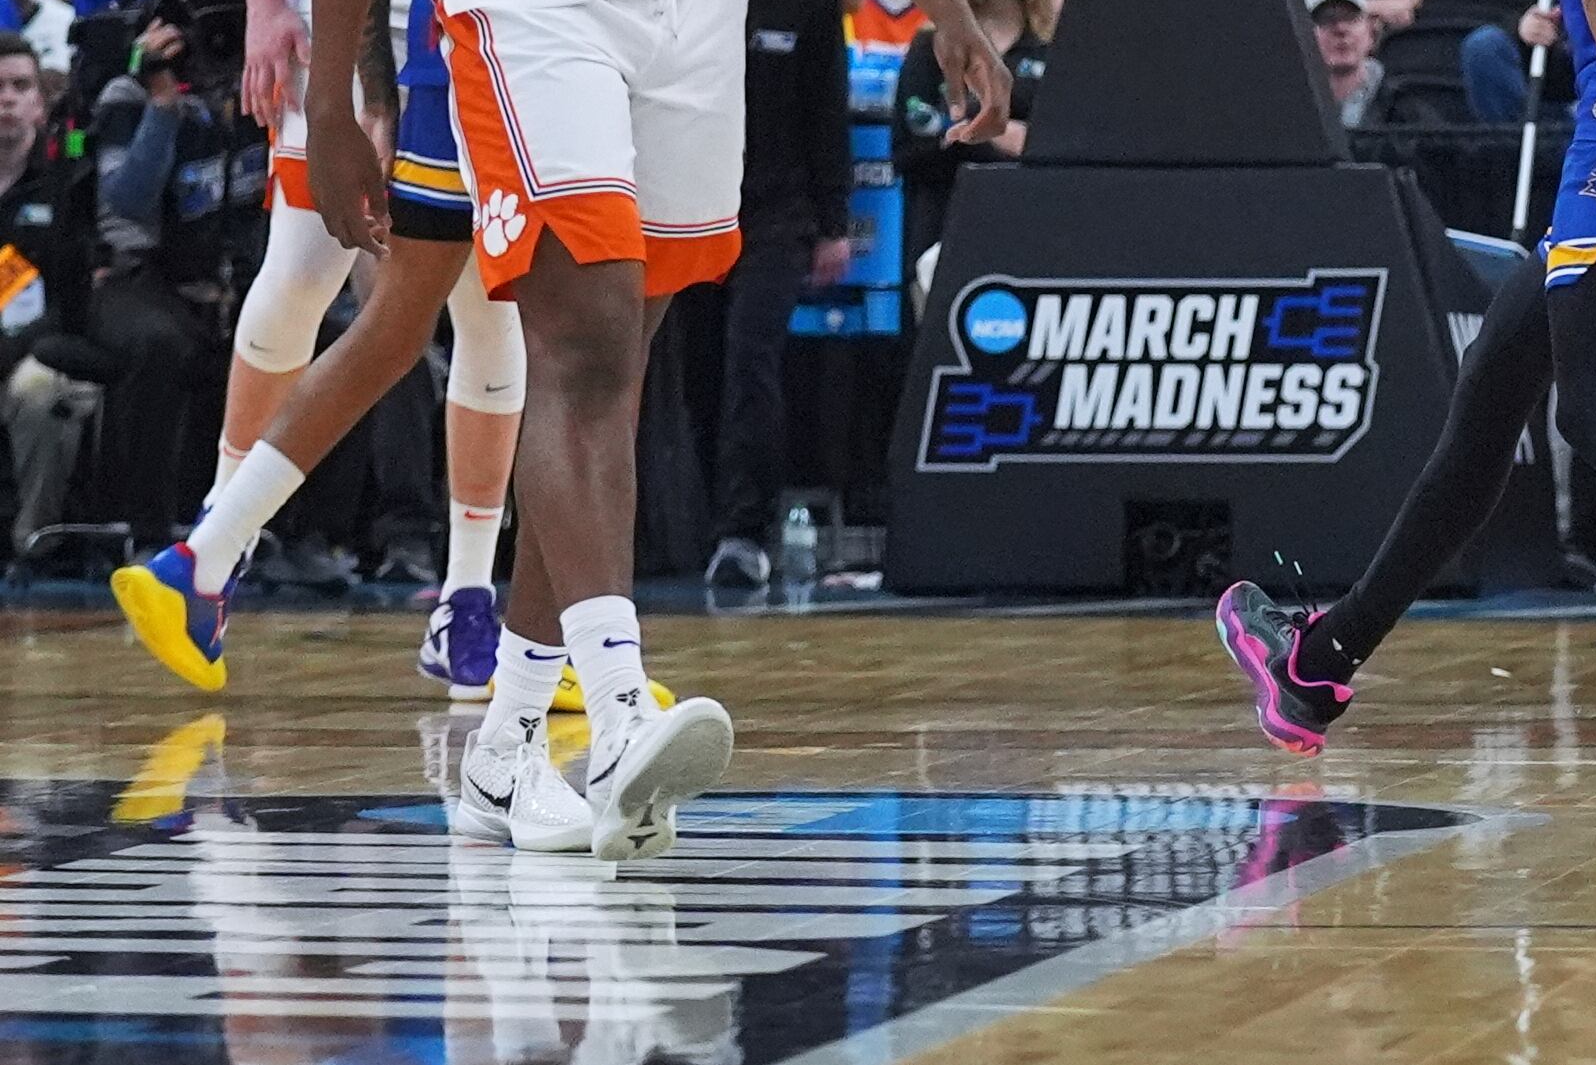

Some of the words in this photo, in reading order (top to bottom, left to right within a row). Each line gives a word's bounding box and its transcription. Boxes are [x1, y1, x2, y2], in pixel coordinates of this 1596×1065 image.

[971, 319, 1025, 338] NCAA
[1027, 294, 1259, 360] MARCH
[1054, 363, 1365, 430] MADNESS
